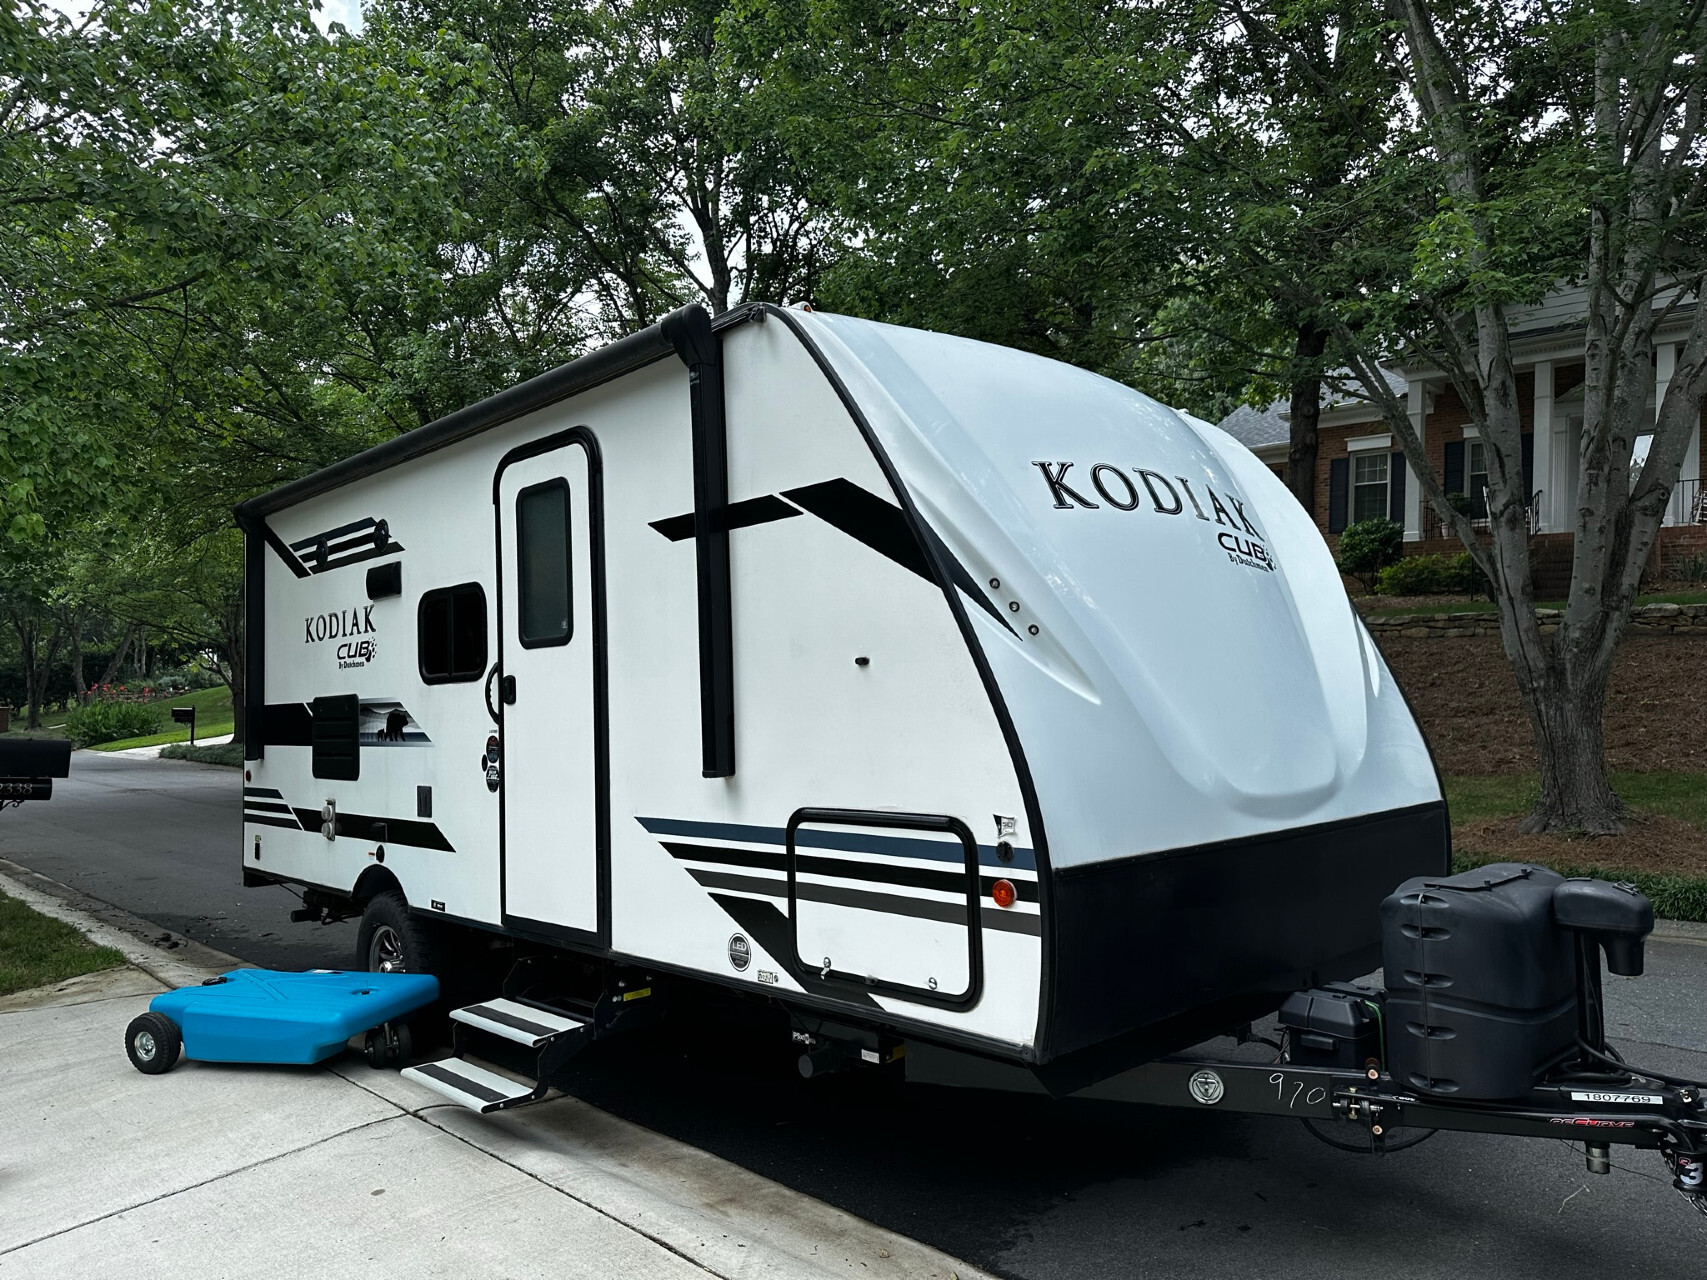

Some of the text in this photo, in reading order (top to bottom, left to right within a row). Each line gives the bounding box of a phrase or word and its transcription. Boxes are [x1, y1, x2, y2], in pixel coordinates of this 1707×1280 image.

[1031, 461, 1265, 542] KODIAK
[1217, 532, 1268, 562] CUB
[305, 604, 376, 643] KODIAK
[337, 641, 371, 660] CUB
[732, 940, 747, 951] LED
[1269, 1073, 1326, 1108] 970
[1584, 1093, 1651, 1103] 1807769
